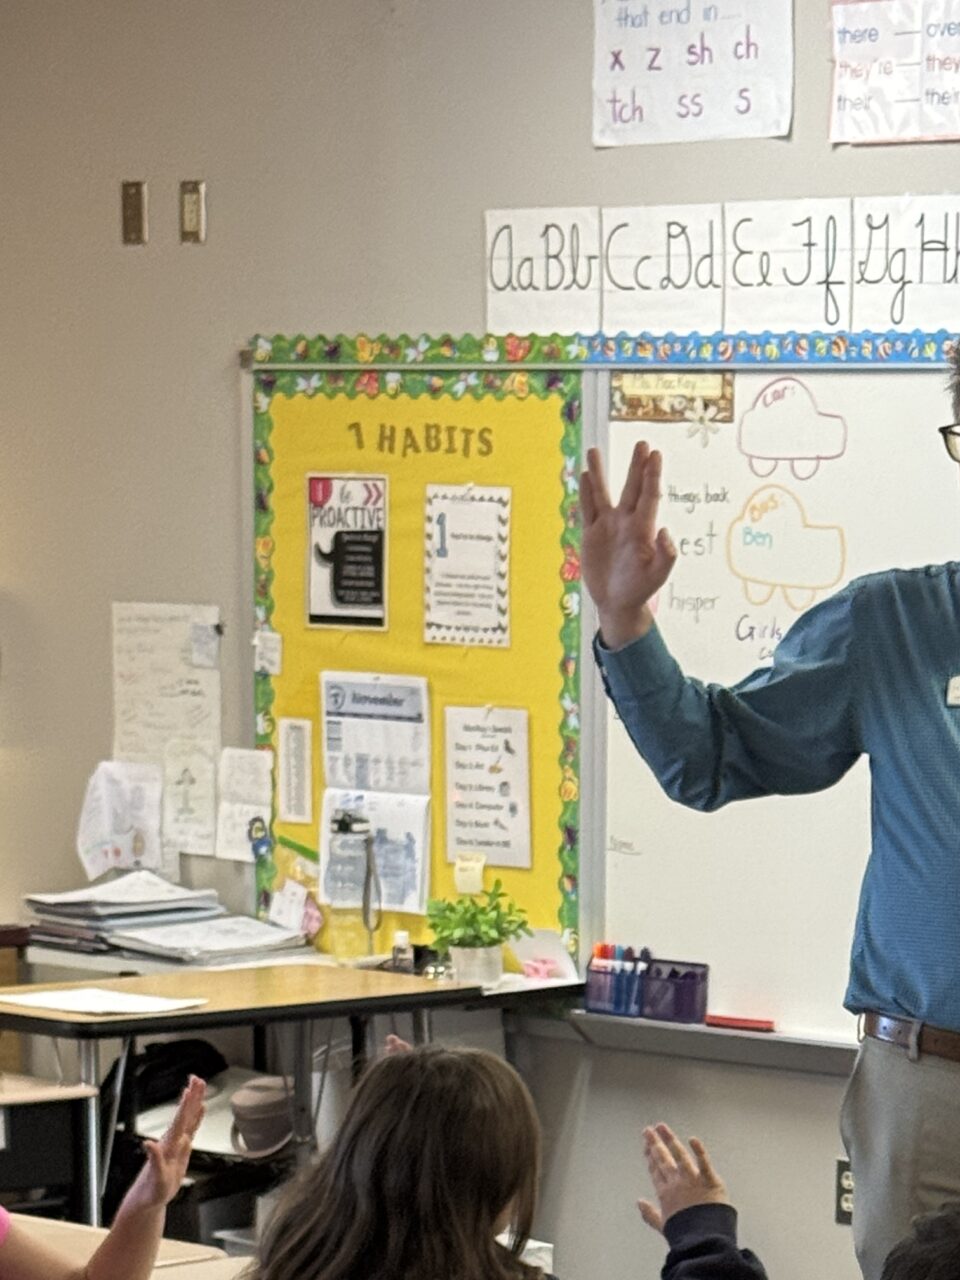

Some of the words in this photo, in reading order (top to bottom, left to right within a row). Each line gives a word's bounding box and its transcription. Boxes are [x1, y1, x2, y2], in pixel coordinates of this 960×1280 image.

[615, 5, 649, 28] that
[658, 5, 690, 24] end
[609, 49, 625, 71] x
[646, 48, 663, 71] z
[686, 31, 713, 66] sh
[733, 24, 759, 59] ch
[837, 27, 879, 44] there
[606, 87, 644, 124] tch
[837, 93, 873, 112] their
[925, 88, 960, 105] their
[377, 422, 494, 459] HABITS
[310, 505, 384, 529] PROACTIVE
[742, 526, 774, 548] Ben
